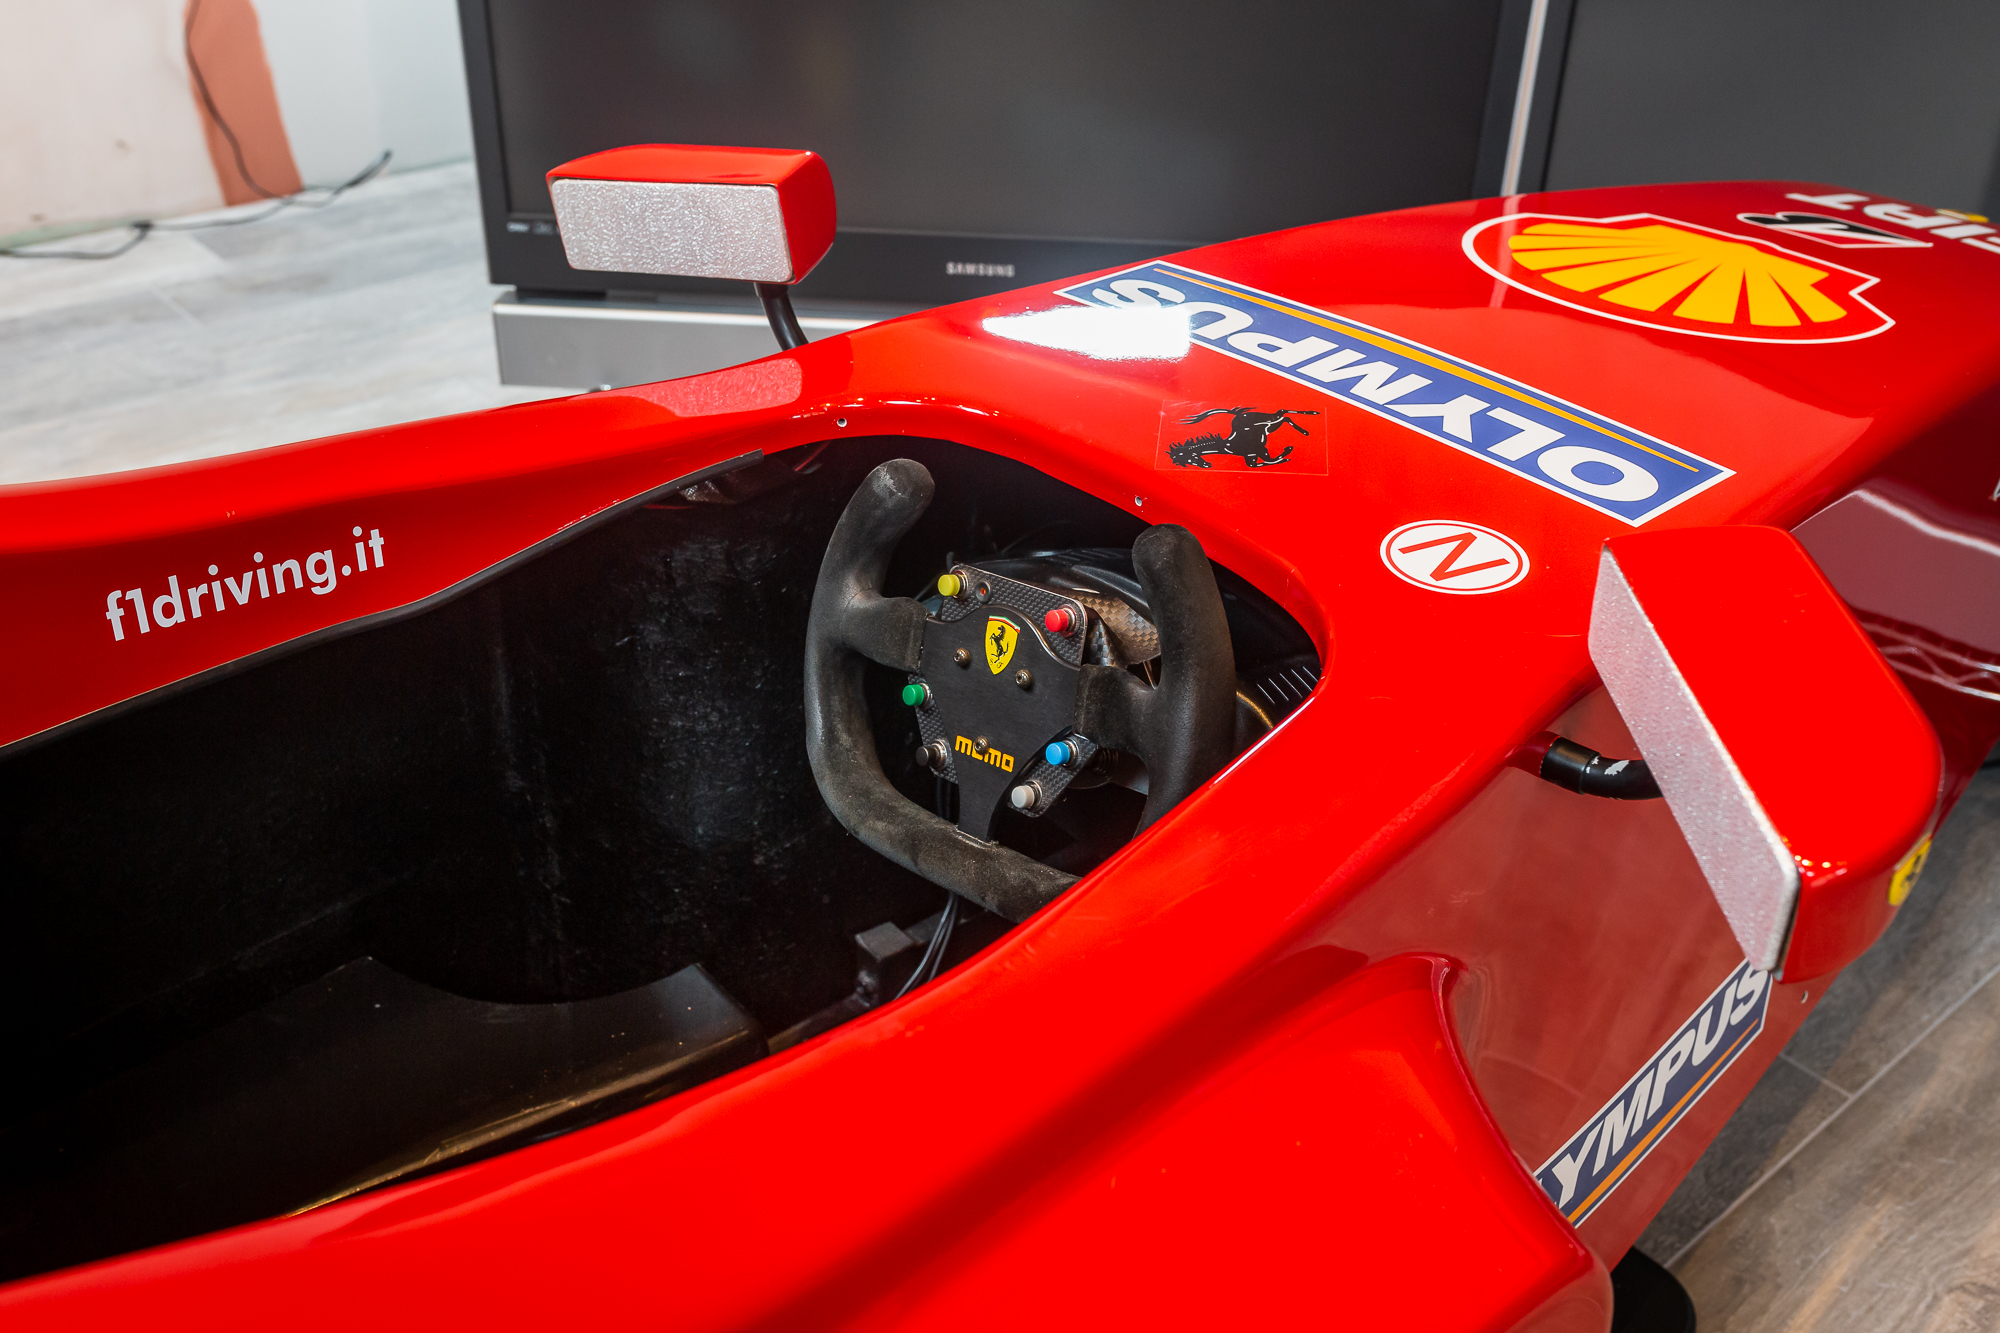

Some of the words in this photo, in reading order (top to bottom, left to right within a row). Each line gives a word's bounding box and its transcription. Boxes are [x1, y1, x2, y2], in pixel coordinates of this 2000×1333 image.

[946, 261, 1015, 278] SAMSUNG
[1092, 279, 1659, 502] OLYMPUS
[105, 526, 385, 641] f1driving.it
[1538, 969, 1769, 1210] YMPUS
